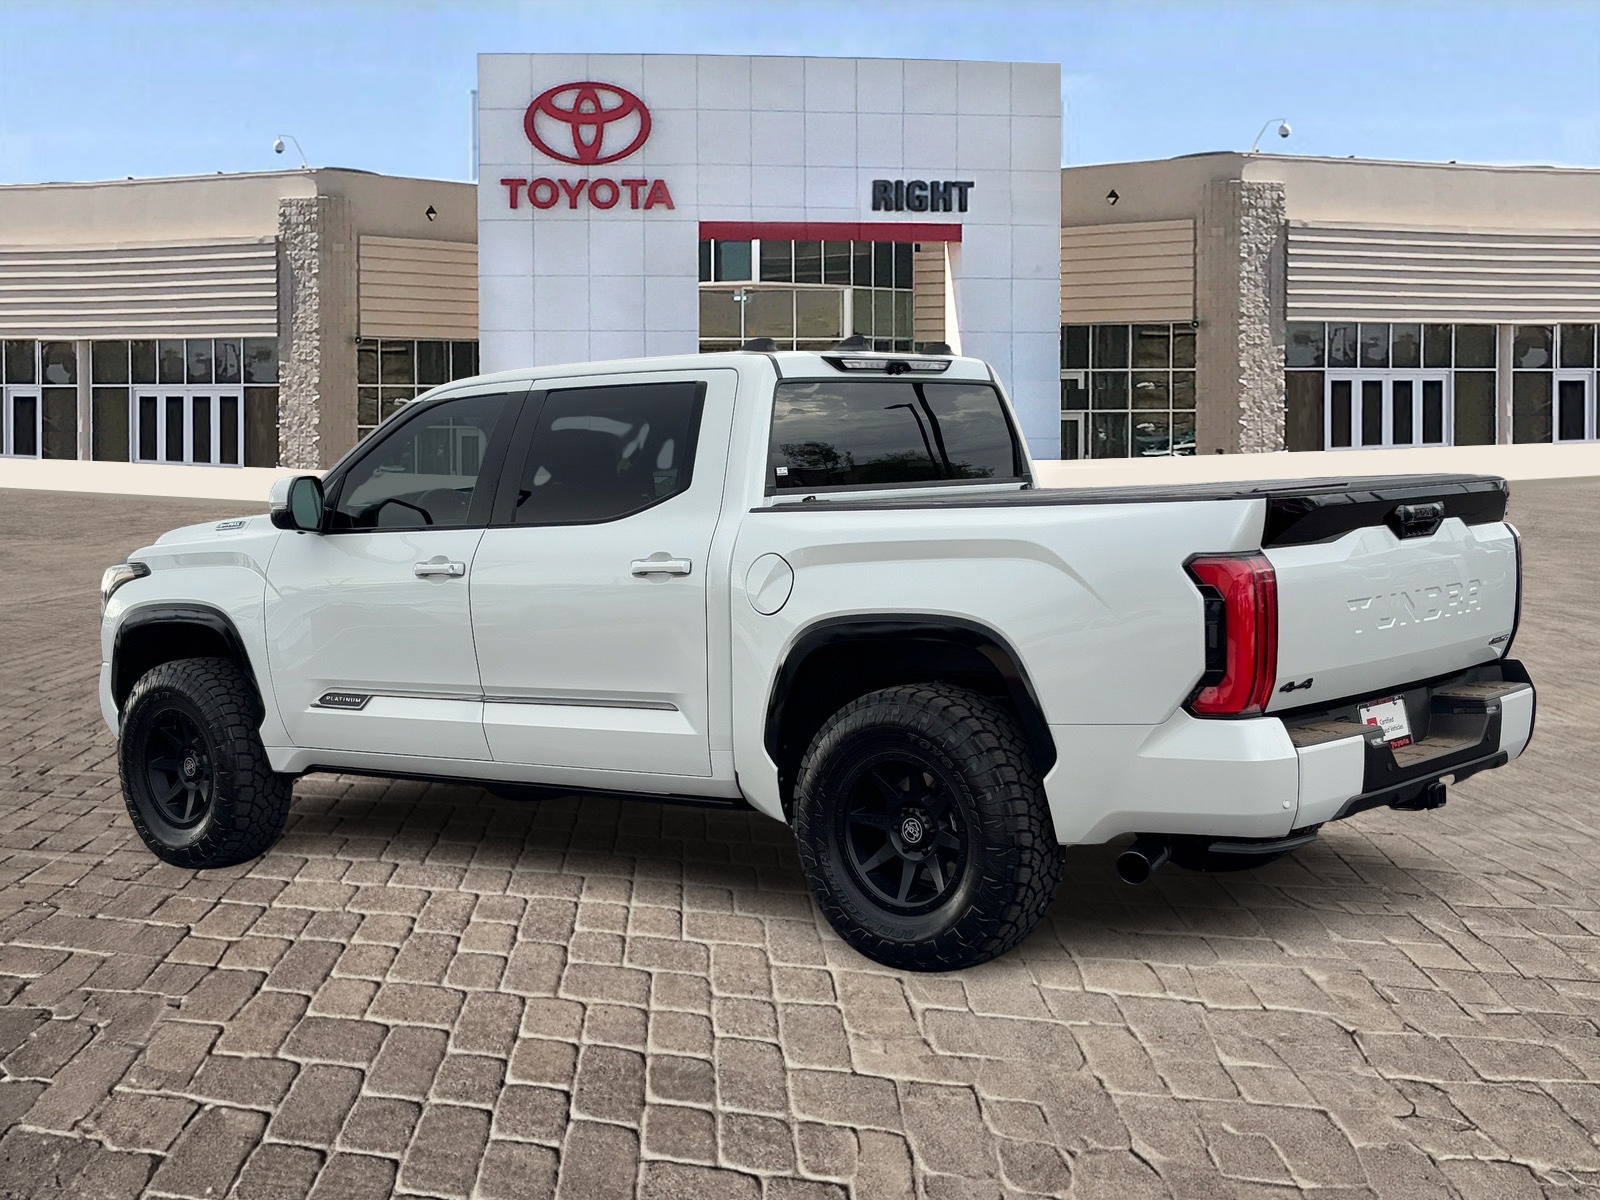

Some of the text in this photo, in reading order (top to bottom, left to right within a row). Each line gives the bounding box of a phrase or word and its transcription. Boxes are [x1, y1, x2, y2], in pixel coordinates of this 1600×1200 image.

[500, 178, 674, 210] TOYOTA
[870, 178, 975, 213] RIGHT
[1347, 579, 1482, 634] TUNDRA
[325, 695, 361, 703] PLATINUM
[1379, 716, 1395, 726] Certified
